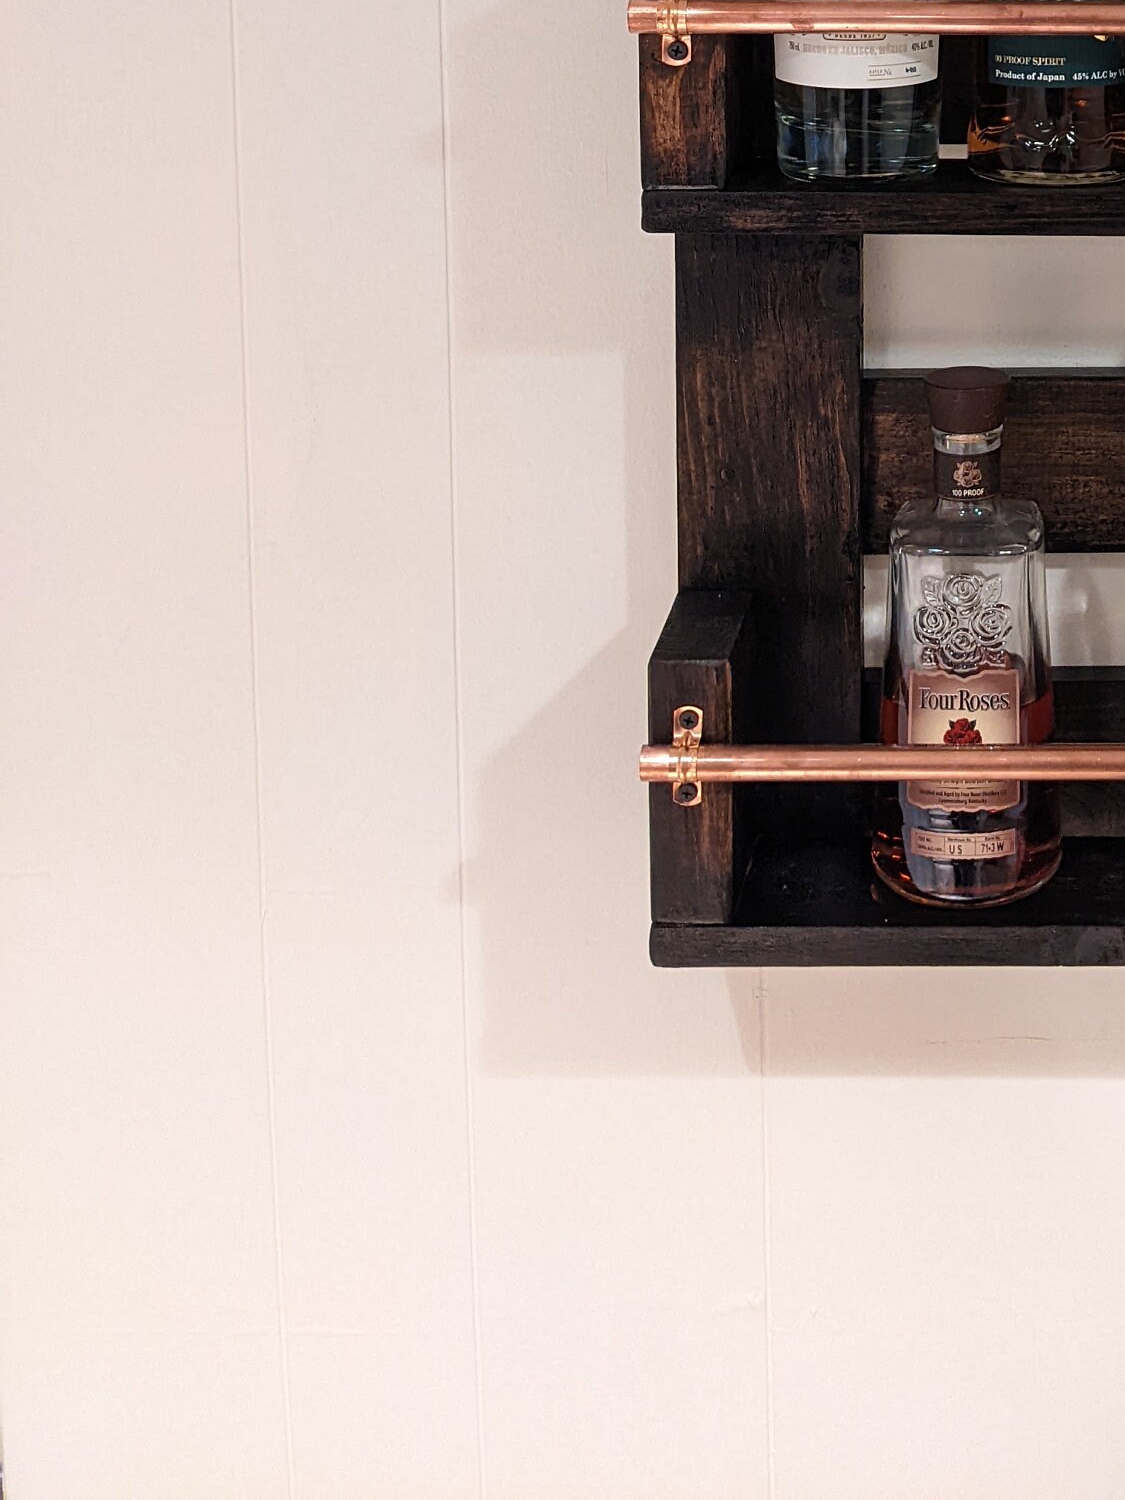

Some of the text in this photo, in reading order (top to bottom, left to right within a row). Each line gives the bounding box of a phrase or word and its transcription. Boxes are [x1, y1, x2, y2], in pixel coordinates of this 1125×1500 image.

[1003, 56, 1032, 65] PROOF
[1032, 57, 1066, 66] SPIRIT
[995, 69, 1065, 82] Product of Japan
[1072, 72, 1089, 80] 45%
[1090, 71, 1108, 80] ALC
[1109, 68, 1118, 79] by
[952, 488, 984, 497] 100 PROOF
[919, 687, 1010, 712] Four Roses
